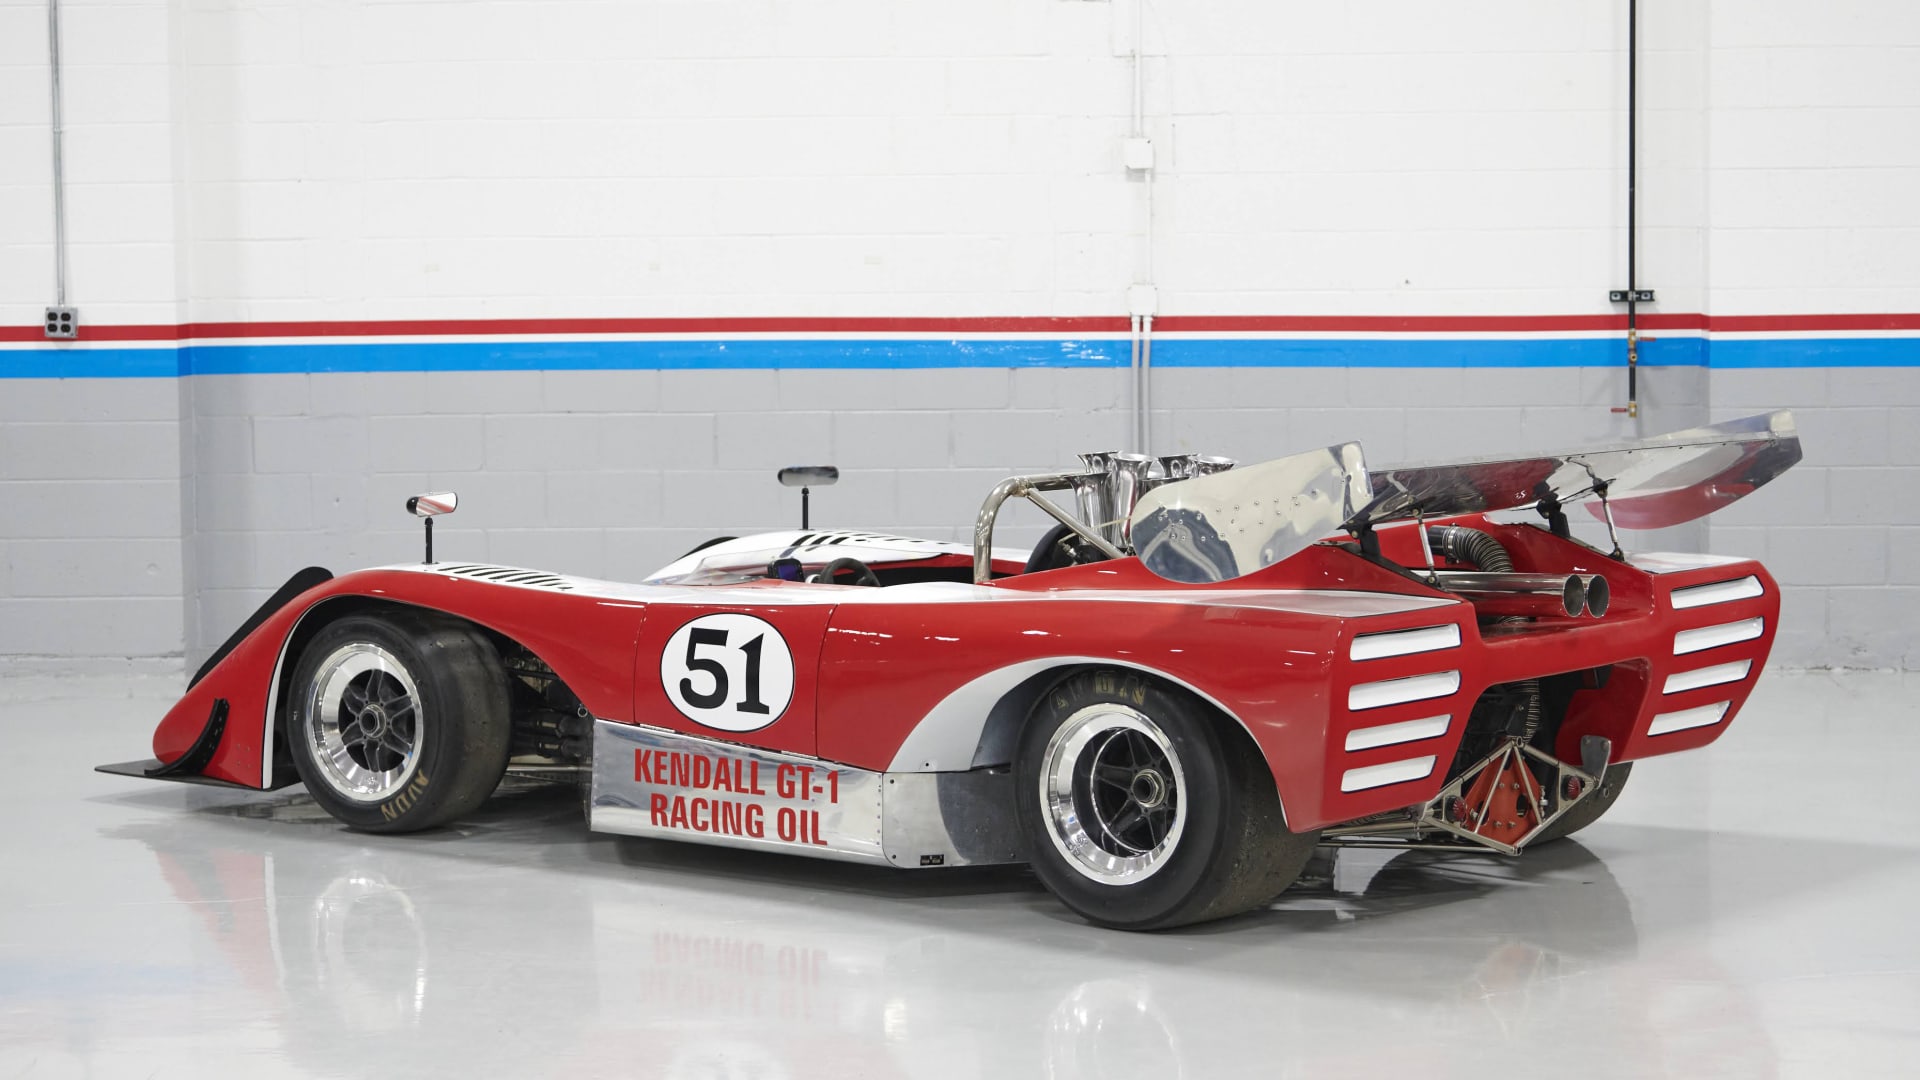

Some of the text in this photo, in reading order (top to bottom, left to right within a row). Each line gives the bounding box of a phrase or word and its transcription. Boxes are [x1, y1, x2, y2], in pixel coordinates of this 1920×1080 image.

[679, 627, 770, 715] 51
[380, 768, 429, 822] AVON
[634, 748, 839, 804] KENDALL GT-1
[650, 793, 828, 846] RACING OIL
